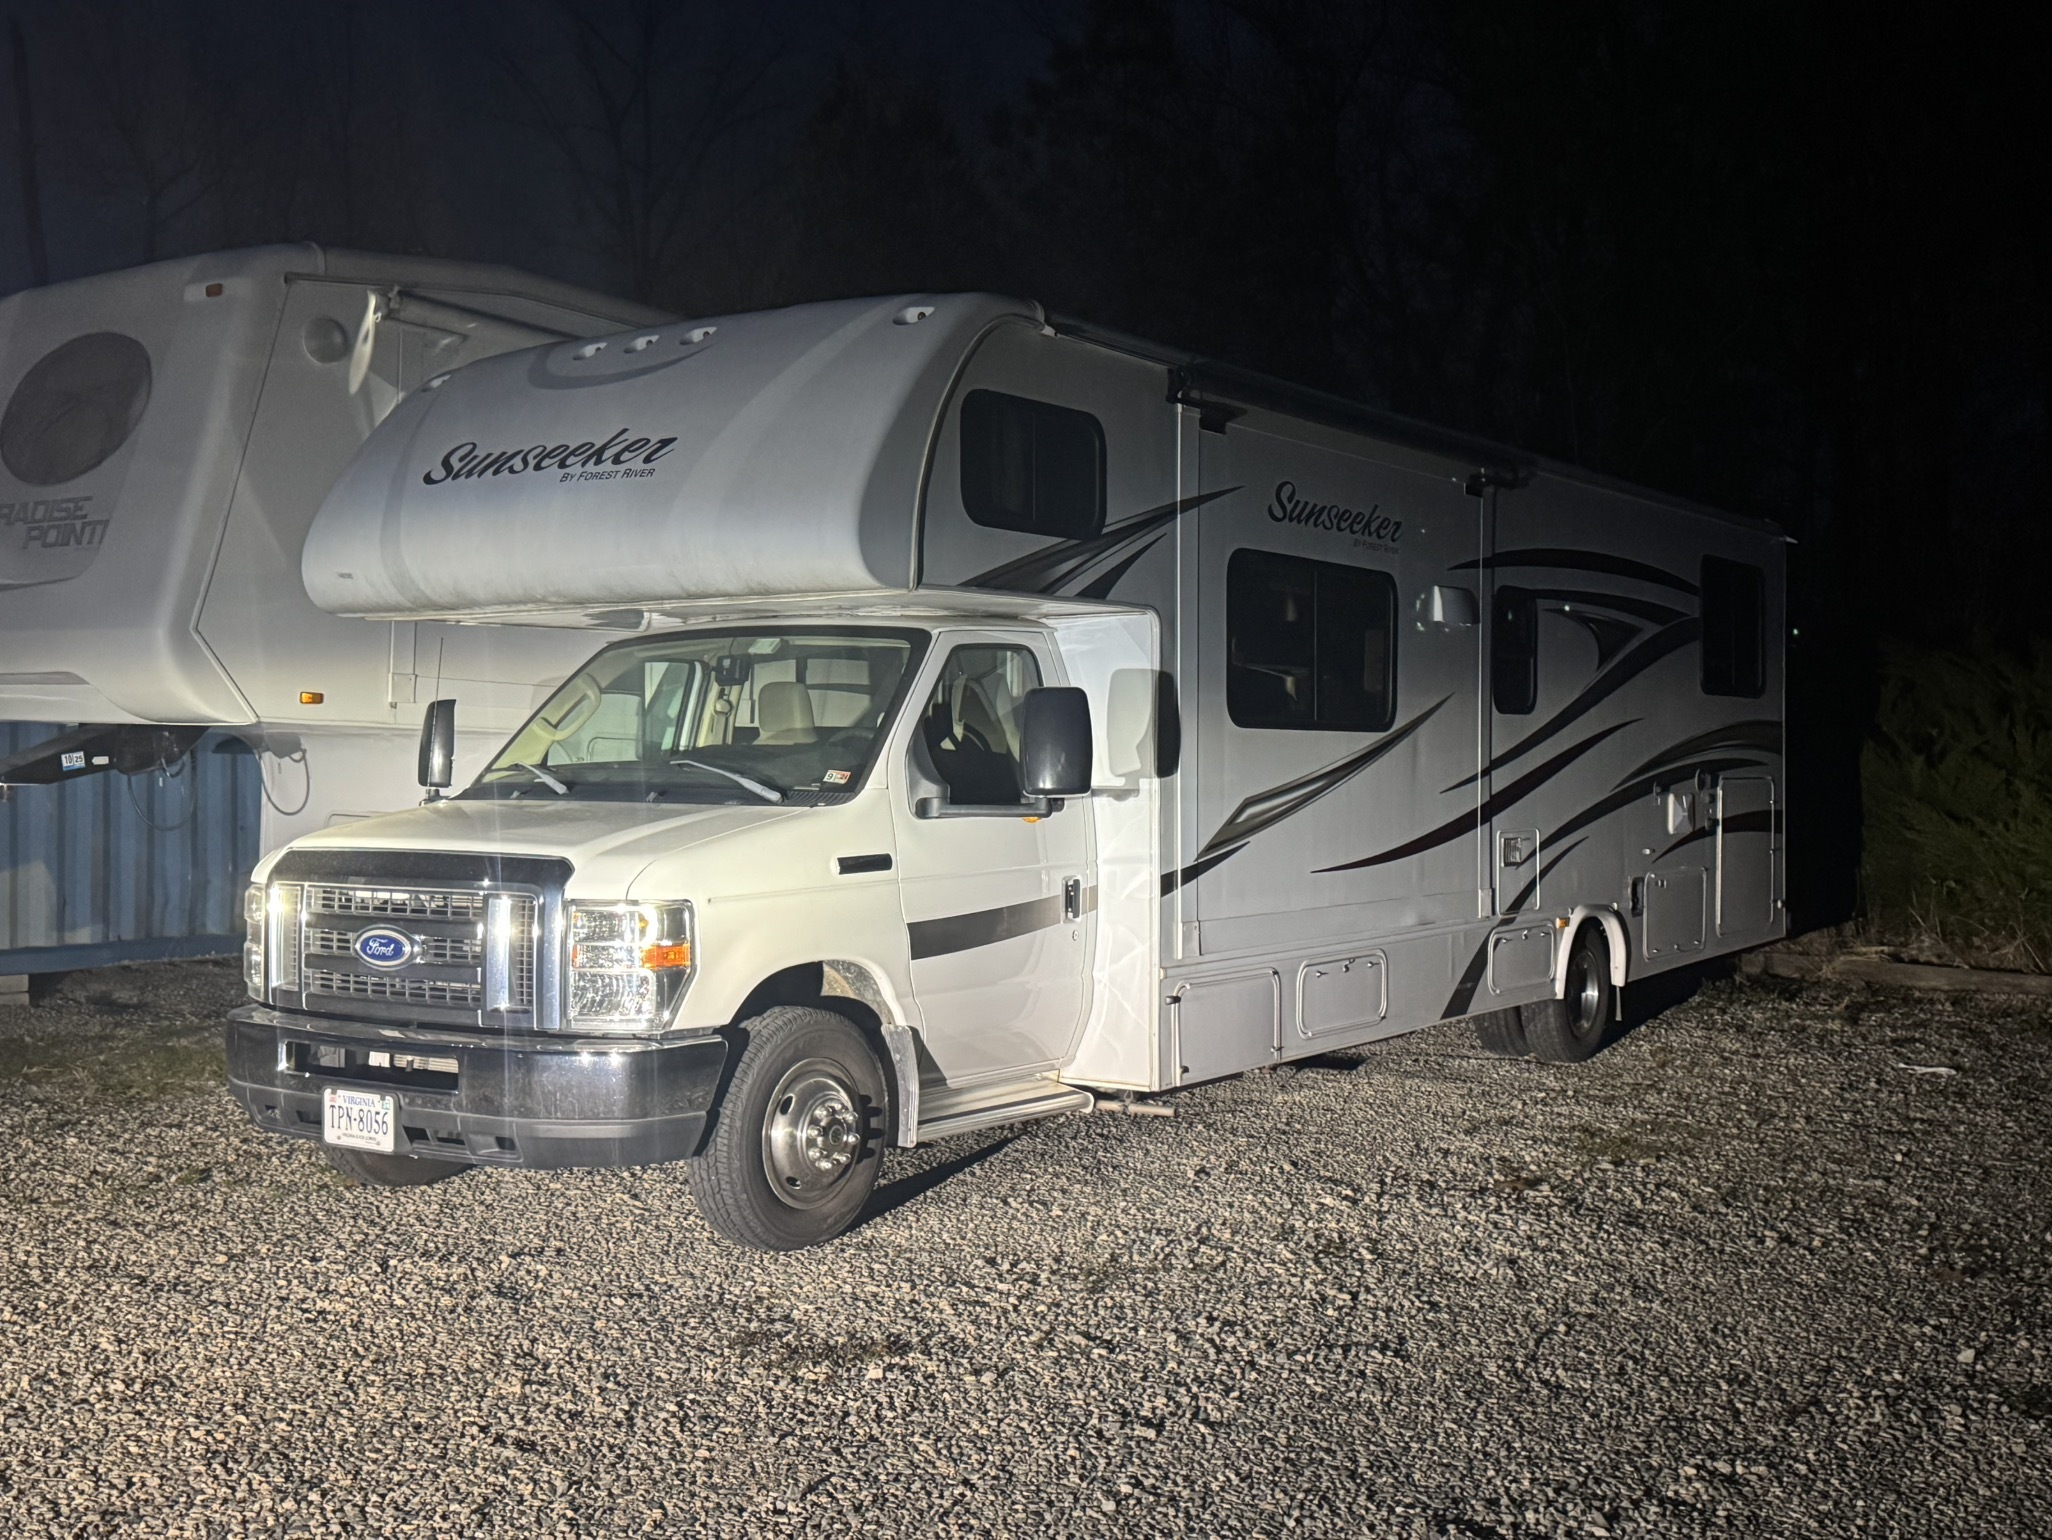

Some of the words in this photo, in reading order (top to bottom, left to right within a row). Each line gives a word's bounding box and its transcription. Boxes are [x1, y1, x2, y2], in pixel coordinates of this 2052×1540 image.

[423, 428, 678, 485] Sunseeker
[577, 471, 621, 481] FOREST
[621, 468, 656, 479] RIVER
[1268, 481, 1402, 543] Sunseeker
[75, 754, 84, 763] 25
[366, 938, 395, 956] Ford
[343, 1095, 376, 1108] VIRGINIA
